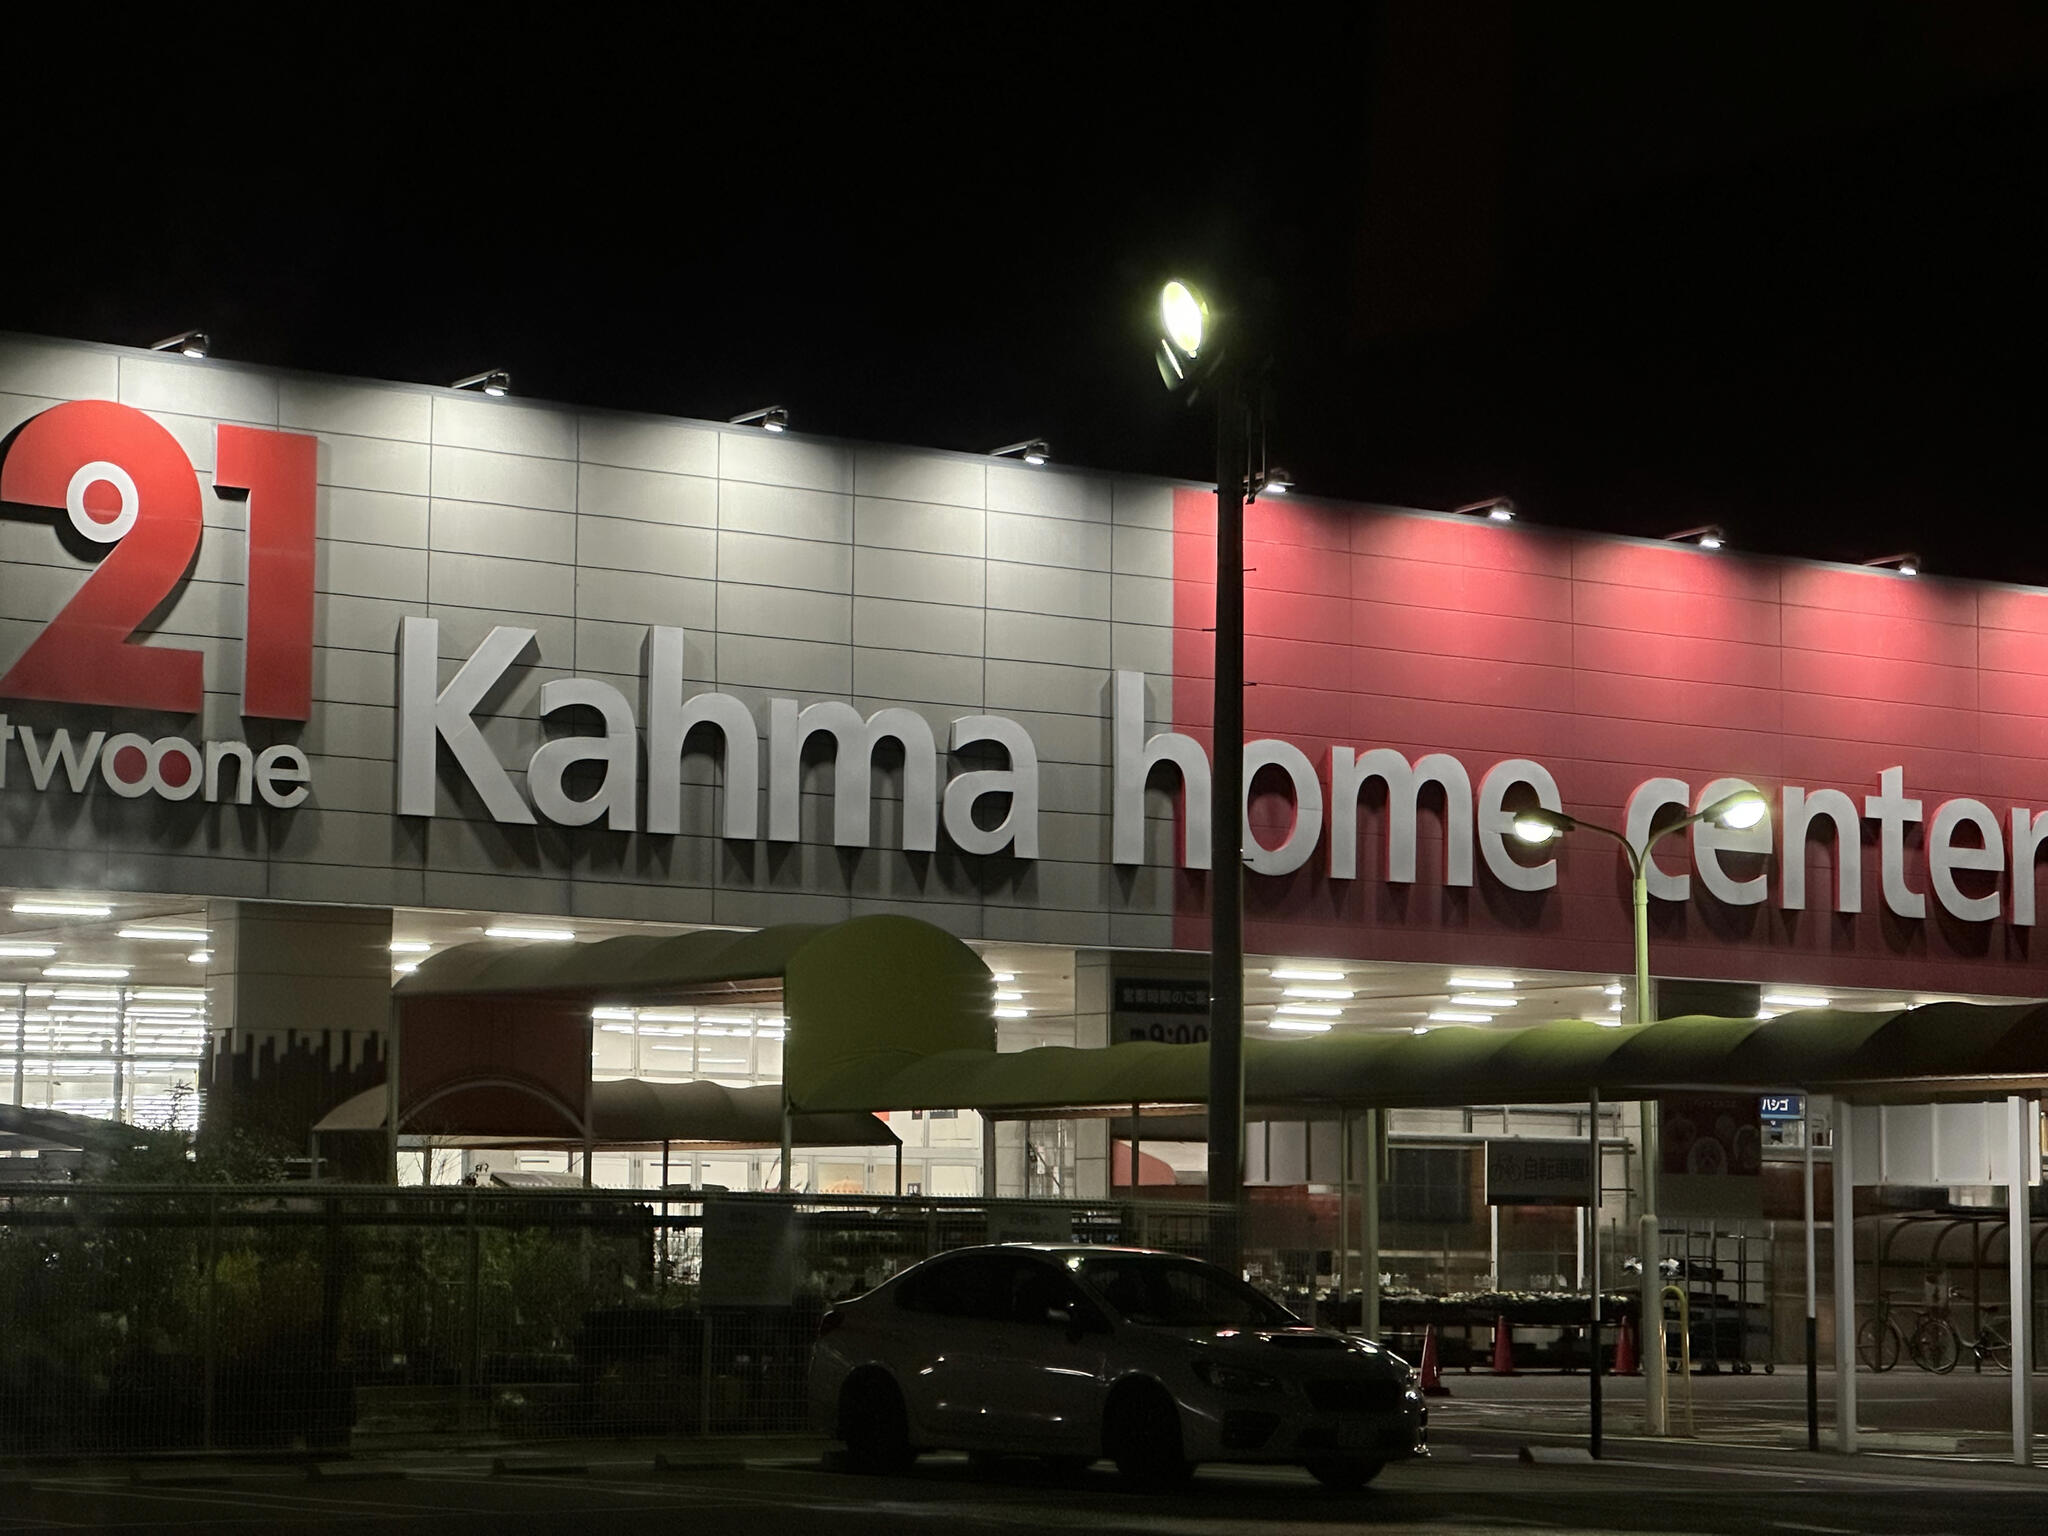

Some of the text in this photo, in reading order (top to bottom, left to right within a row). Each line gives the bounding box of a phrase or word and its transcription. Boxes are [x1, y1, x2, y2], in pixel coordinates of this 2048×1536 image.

[0, 400, 317, 722] 21
[398, 616, 2048, 926] Kahma home center
[1762, 1098, 1789, 1112] ハシゴ
